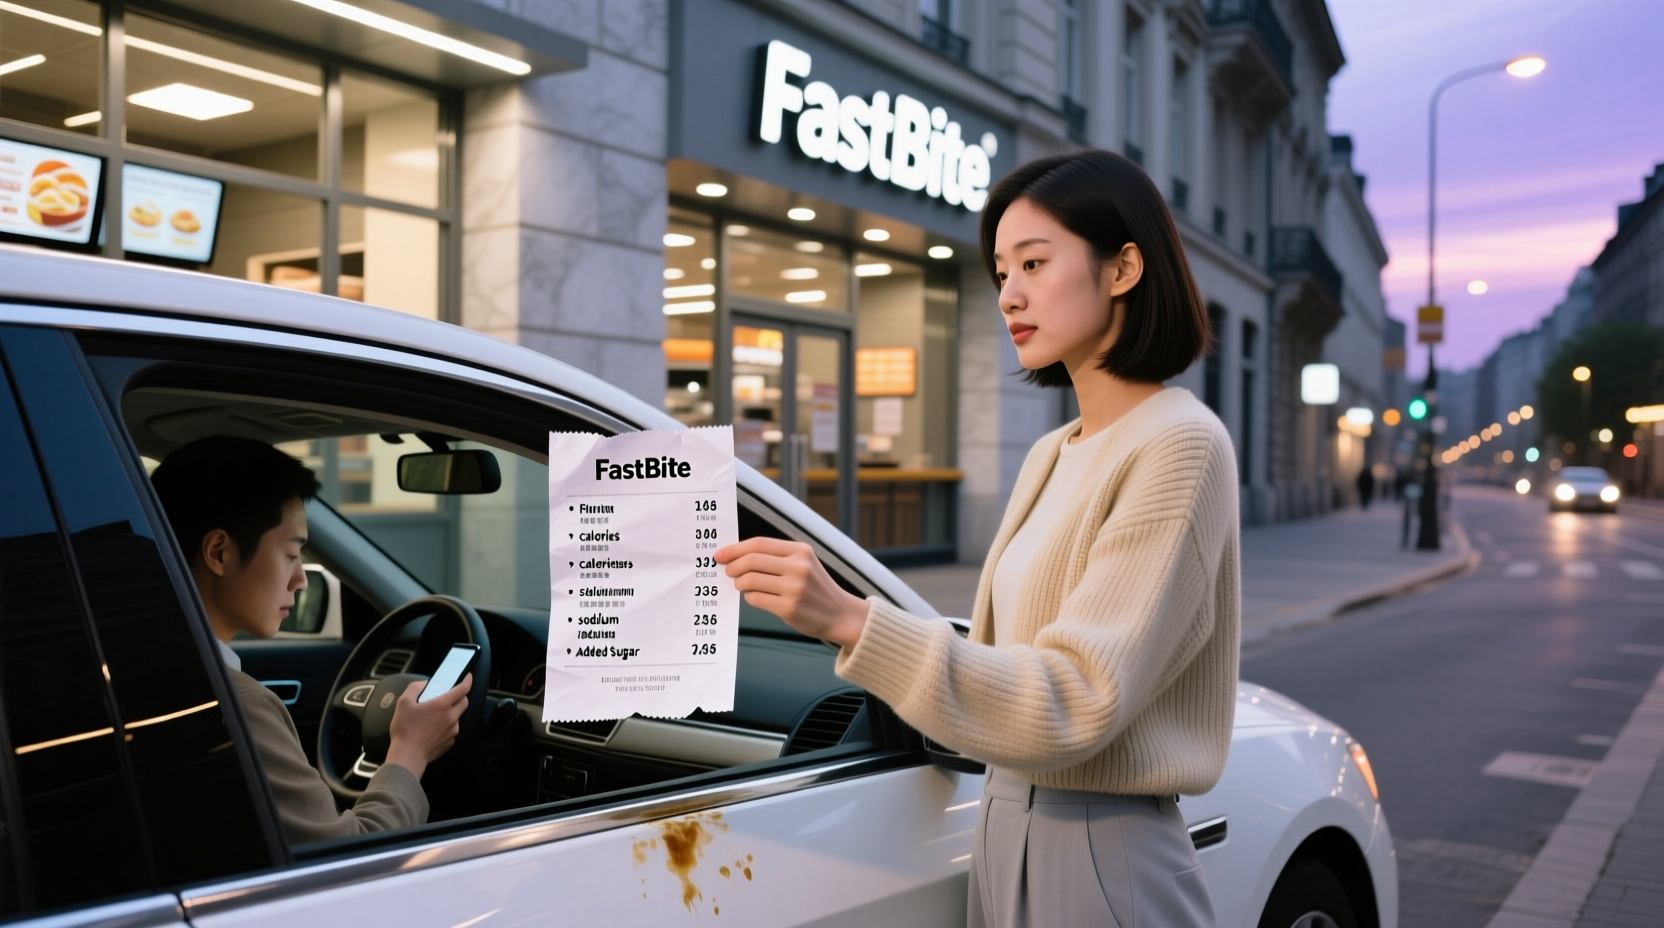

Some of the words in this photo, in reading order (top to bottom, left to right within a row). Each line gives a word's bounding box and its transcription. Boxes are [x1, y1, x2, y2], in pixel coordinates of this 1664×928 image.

[760, 39, 991, 212] FastBite
[595, 455, 691, 480] FastBite
[575, 645, 608, 658] Added
[609, 646, 640, 661] Sugar
